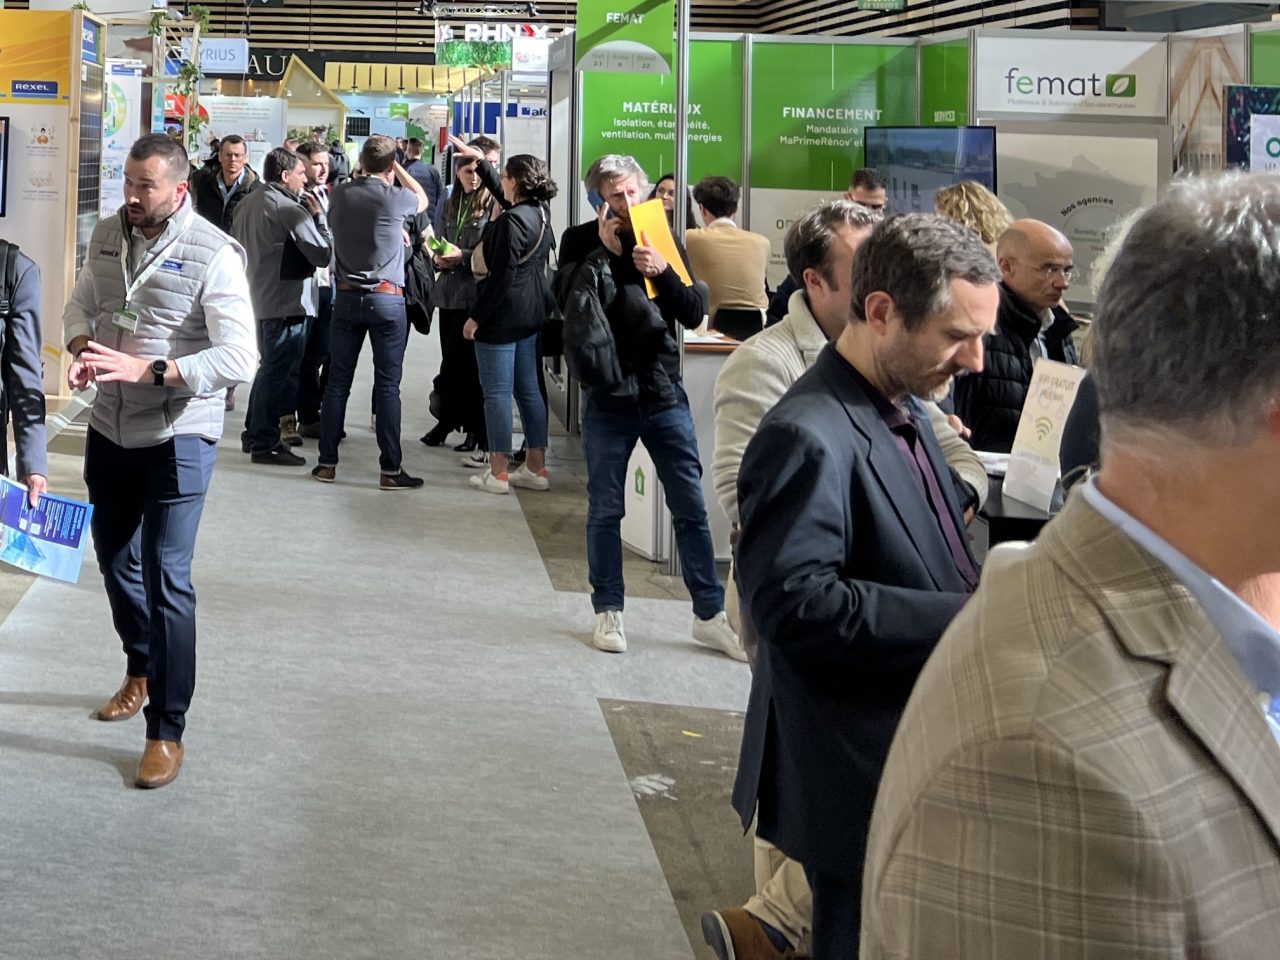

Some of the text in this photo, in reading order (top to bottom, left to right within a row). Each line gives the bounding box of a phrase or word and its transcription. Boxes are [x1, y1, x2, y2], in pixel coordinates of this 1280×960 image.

[606, 12, 645, 25] FEMAT
[248, 54, 288, 77] AU
[1004, 67, 1102, 97] femat
[622, 100, 702, 115] MATÉRIUX
[782, 106, 883, 121] FINANCEMENT
[806, 124, 859, 135] Mandataire
[1060, 196, 1114, 217] Nos agences
